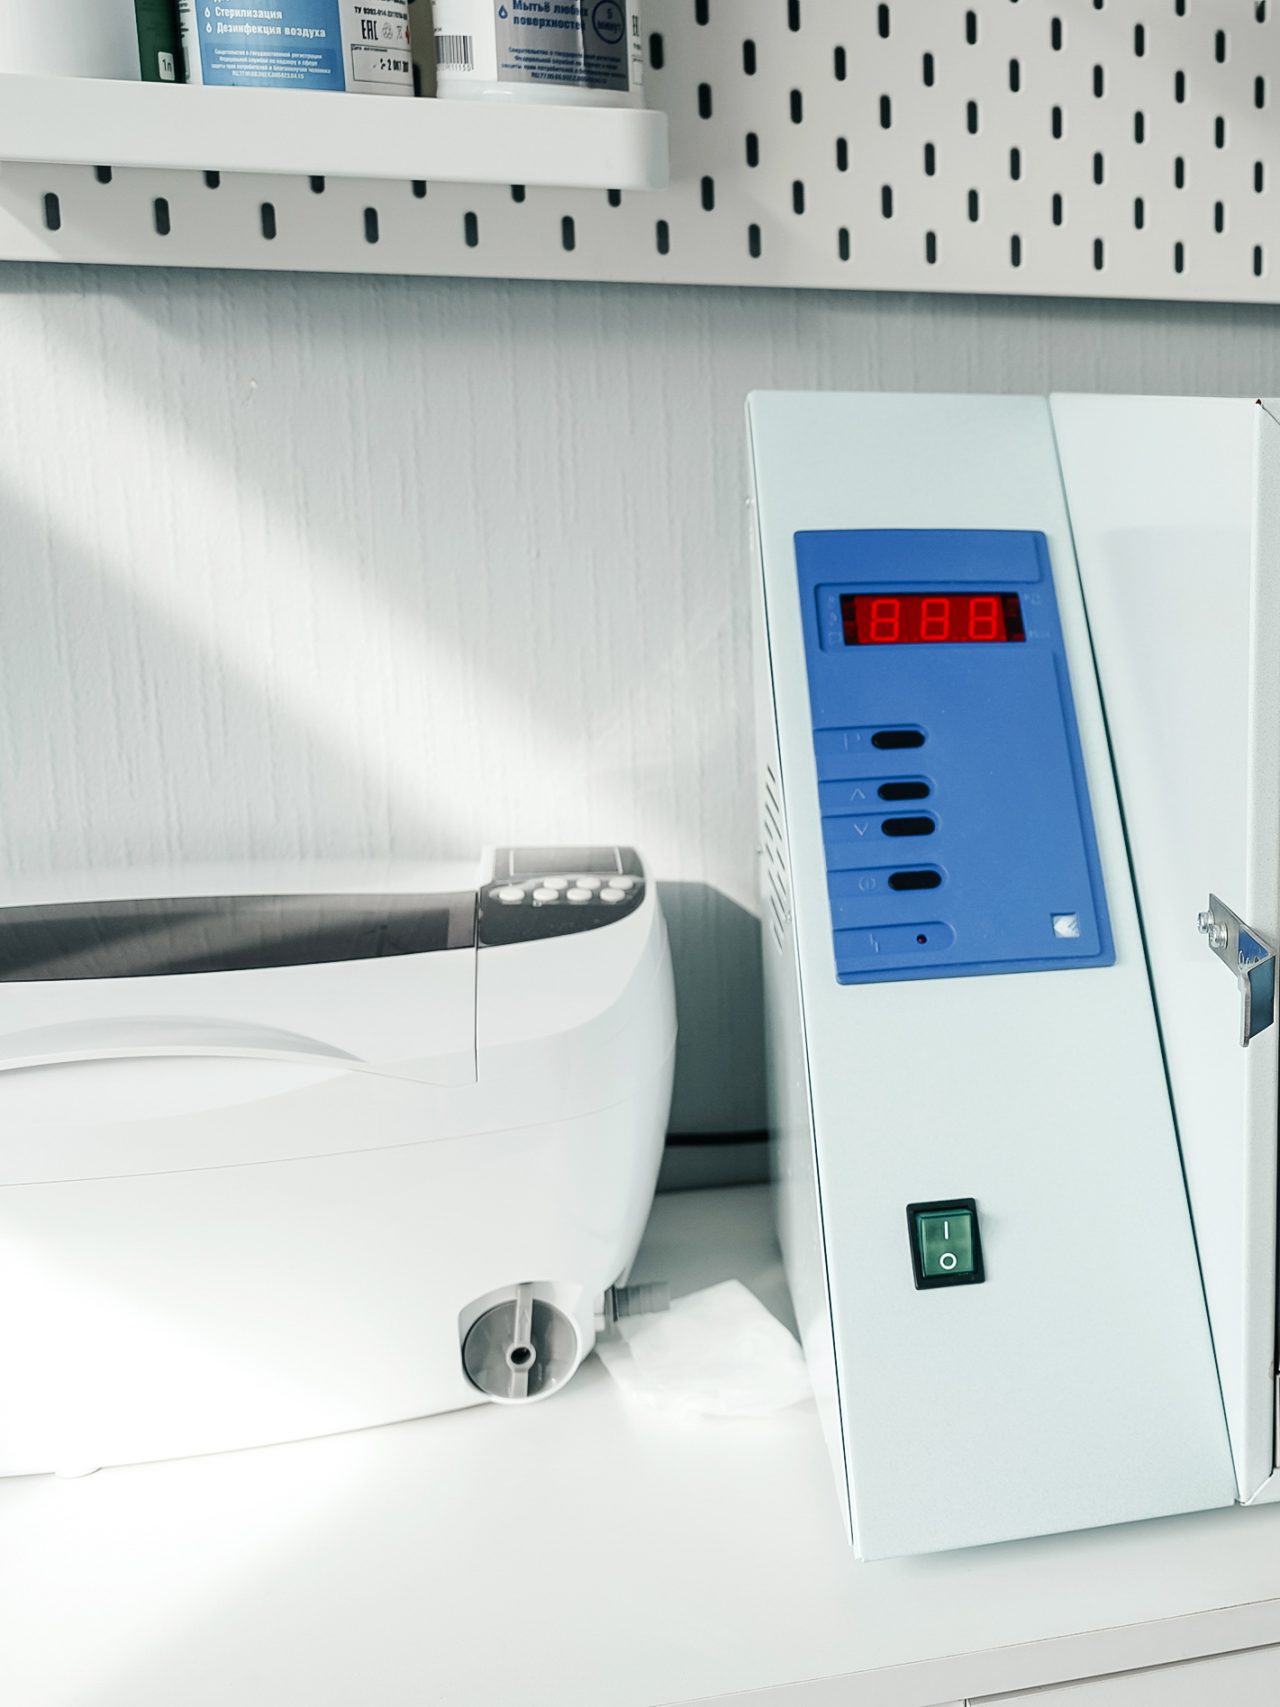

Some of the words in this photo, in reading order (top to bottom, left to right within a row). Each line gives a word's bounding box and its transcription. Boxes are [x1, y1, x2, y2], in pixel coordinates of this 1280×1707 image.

[214, 6, 283, 20] Стерилизация
[216, 22, 283, 38] Дезинфекция
[285, 25, 327, 39] воздуха
